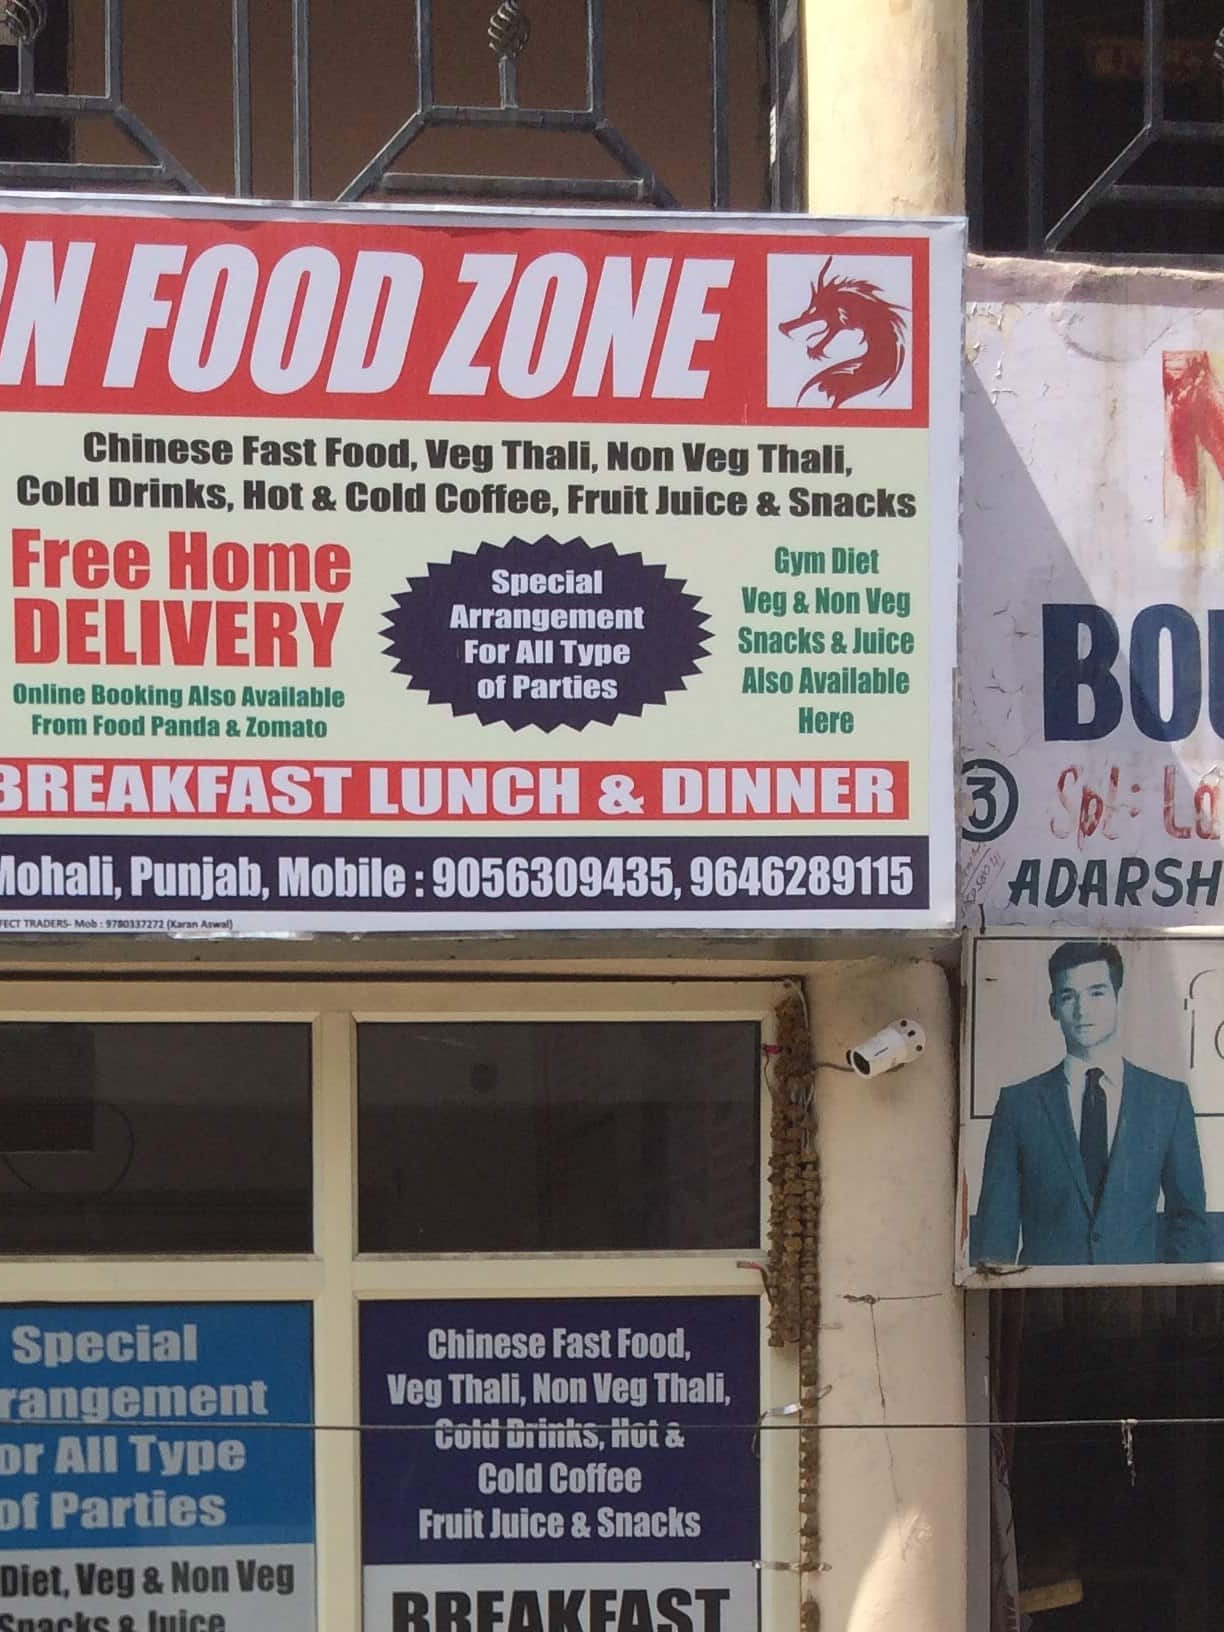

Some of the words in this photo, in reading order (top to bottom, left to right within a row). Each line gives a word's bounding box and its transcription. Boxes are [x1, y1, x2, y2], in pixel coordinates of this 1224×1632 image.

[102, 244, 424, 395] FOOD
[428, 253, 734, 398] ZONE
[83, 432, 233, 464] Chinese
[242, 436, 316, 467] Fast
[326, 438, 417, 471] Food,
[425, 439, 493, 473] Veg
[502, 441, 598, 474] Thali,
[607, 442, 673, 472] Non
[682, 443, 749, 475] Veg
[758, 444, 852, 477] Thali,
[17, 475, 98, 506] Cold
[109, 477, 234, 512] Drinks,
[243, 480, 304, 510] Hot
[312, 485, 336, 511] &
[345, 481, 425, 513] Cold
[435, 484, 559, 517] Coffee,
[568, 485, 648, 515] Fruit
[656, 486, 747, 516] Juice
[756, 491, 781, 516] &
[788, 487, 916, 518] Snacks
[12, 528, 150, 590] Free
[169, 531, 352, 592] Home
[774, 546, 825, 577] Gym
[831, 547, 879, 574] Diet
[491, 569, 603, 596] Special
[450, 604, 645, 632] Arrangement
[741, 586, 787, 617] Veg
[792, 591, 810, 614] &
[815, 587, 860, 614] Non
[865, 587, 911, 618] Veg
[14, 598, 344, 668] DELIVERY
[738, 626, 825, 654] Snacks
[830, 631, 847, 654] &
[852, 627, 915, 654] Juice
[464, 640, 510, 664] For
[516, 640, 553, 664] All
[560, 640, 631, 666] Type
[13, 683, 85, 705] Online
[91, 684, 183, 708] Booking
[188, 685, 236, 707] Also
[241, 686, 345, 708] Available
[477, 675, 506, 699] of
[512, 675, 618, 699] Parties
[742, 667, 793, 694] Also
[798, 667, 910, 694] Available
[32, 714, 87, 736] From
[93, 716, 145, 737] Food
[151, 716, 220, 737] Panda
[226, 719, 241, 737] &
[246, 717, 327, 738] Zomato
[798, 707, 854, 734] Here
[369, 765, 579, 815] LUNCH
[597, 774, 644, 815] &
[662, 767, 894, 814] DINNER
[131, 855, 270, 901] Punjab,
[278, 856, 405, 898] Mobile
[432, 856, 682, 900] 9056309435,
[690, 855, 913, 896] 9646289115
[1007, 857, 1224, 908] ADARSH
[75, 919, 98, 929] Mob
[11, 1324, 198, 1367] Special
[428, 1329, 546, 1360] Chinese
[552, 1327, 612, 1359] Fast
[617, 1327, 691, 1361] Food,
[387, 1373, 443, 1408] Veg
[448, 1373, 527, 1407] Thali,
[532, 1373, 587, 1403] Non
[592, 1373, 648, 1407] Veg
[653, 1373, 731, 1406] Thali,
[434, 1418, 500, 1449] Cold
[506, 1418, 605, 1451] Drinks,
[610, 1418, 659, 1448] Hot
[665, 1422, 685, 1448] &
[54, 1435, 117, 1475] All
[128, 1434, 246, 1477] Type
[478, 1462, 542, 1494] Cold
[549, 1462, 642, 1494] Coffee
[50, 1489, 226, 1530] Parties
[419, 1508, 485, 1540] Fruit
[490, 1508, 564, 1539] Juice
[571, 1511, 591, 1538] &
[597, 1507, 701, 1538] Snacks
[0, 1564, 70, 1599] Diet,
[75, 1563, 135, 1599] Veg
[142, 1566, 164, 1595] &
[171, 1560, 230, 1594] Non
[236, 1559, 295, 1595] Veg
